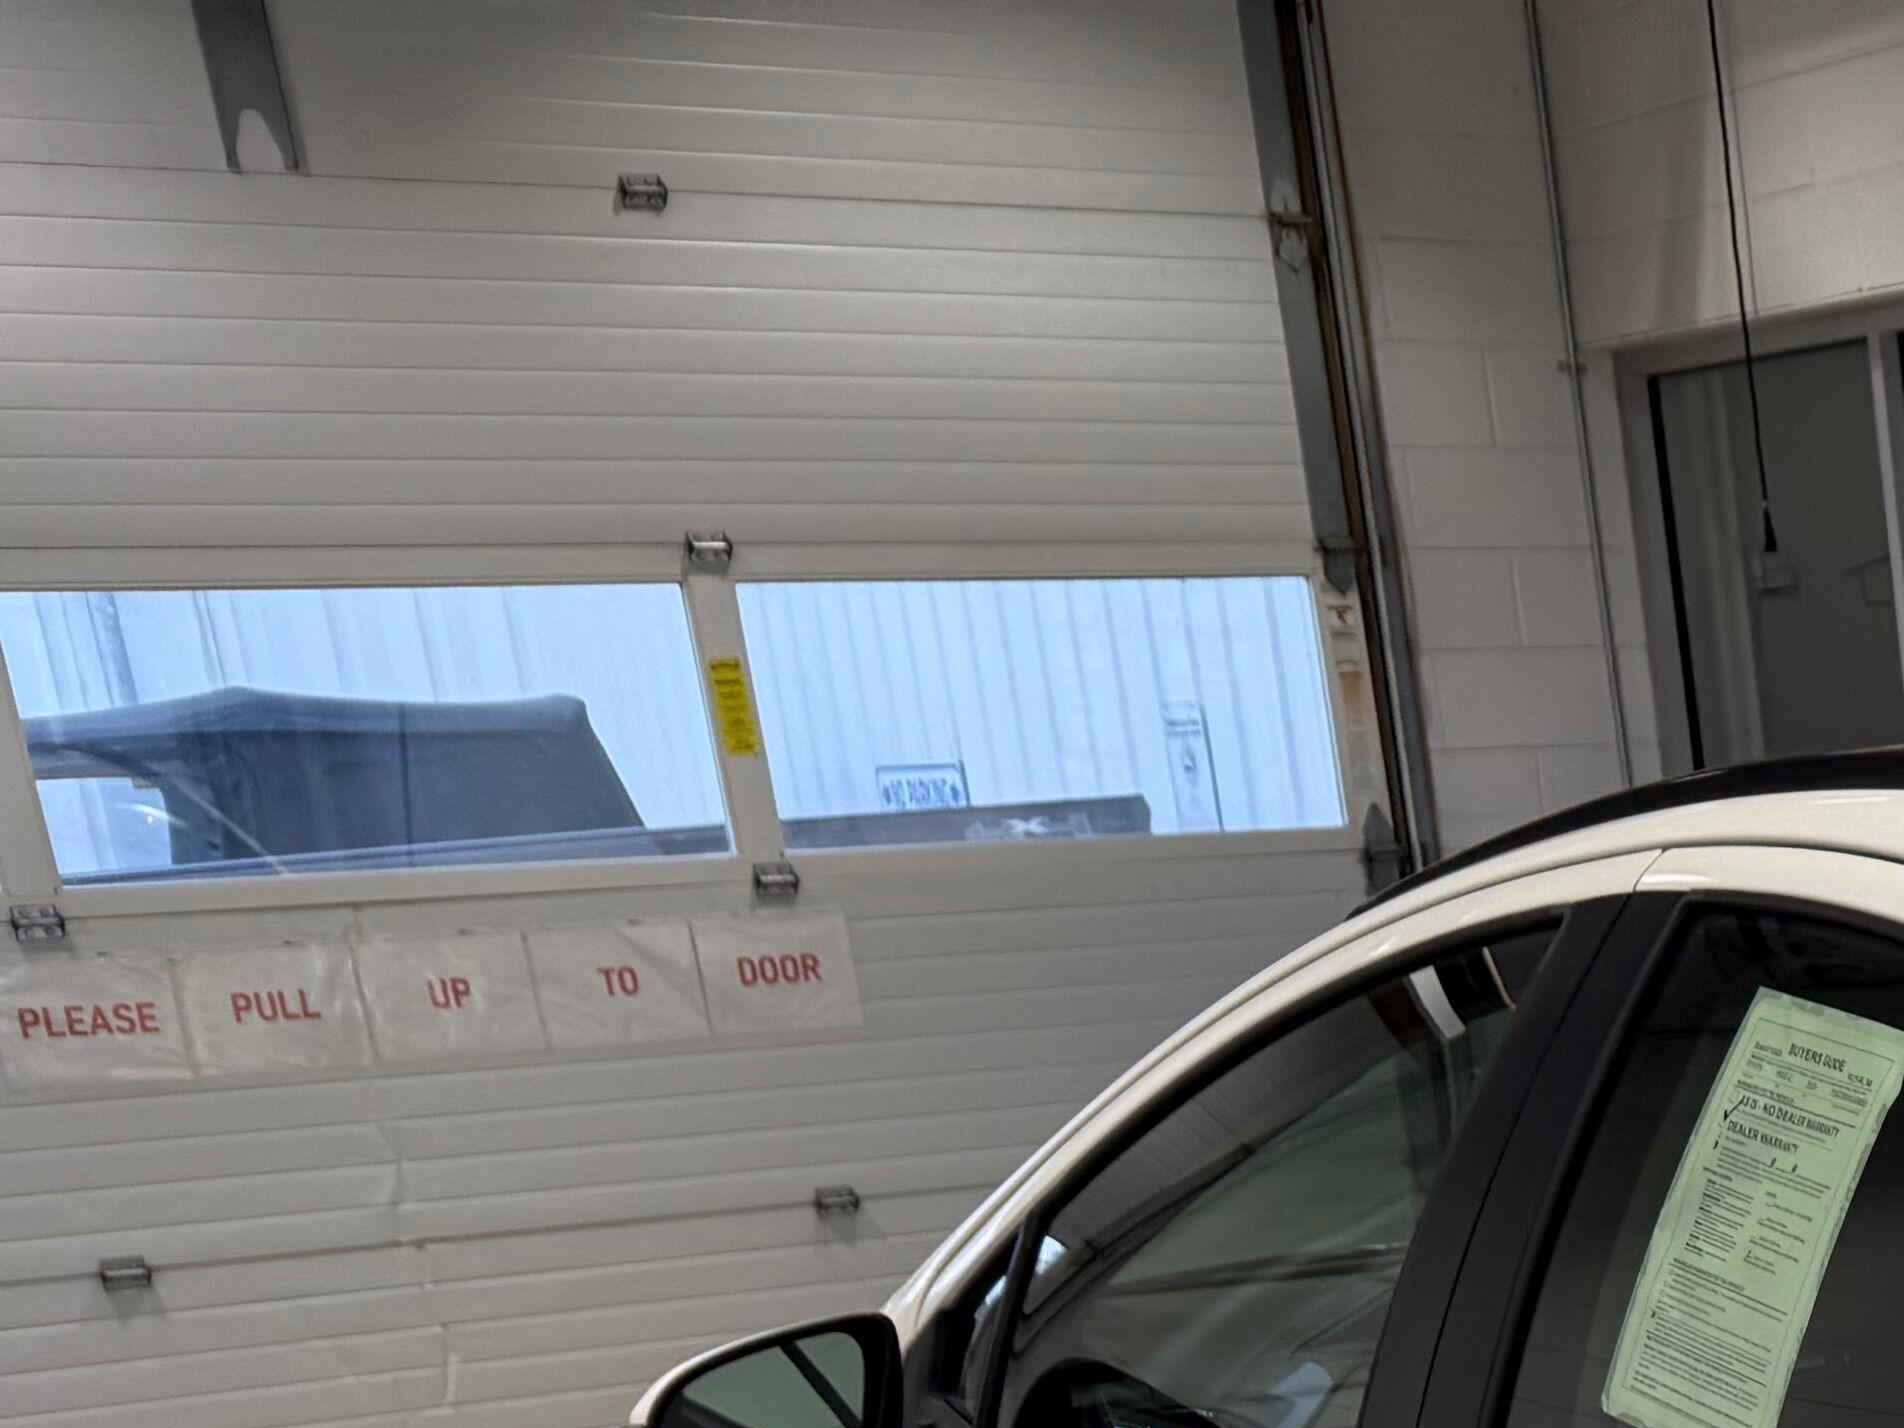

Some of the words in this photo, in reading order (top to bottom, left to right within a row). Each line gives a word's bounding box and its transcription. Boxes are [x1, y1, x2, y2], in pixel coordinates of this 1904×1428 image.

[16, 1002, 160, 1039] PLEASE
[229, 989, 321, 1023] PULL
[426, 976, 471, 1009] UP
[597, 965, 639, 997] TO
[736, 952, 823, 988] DOOR
